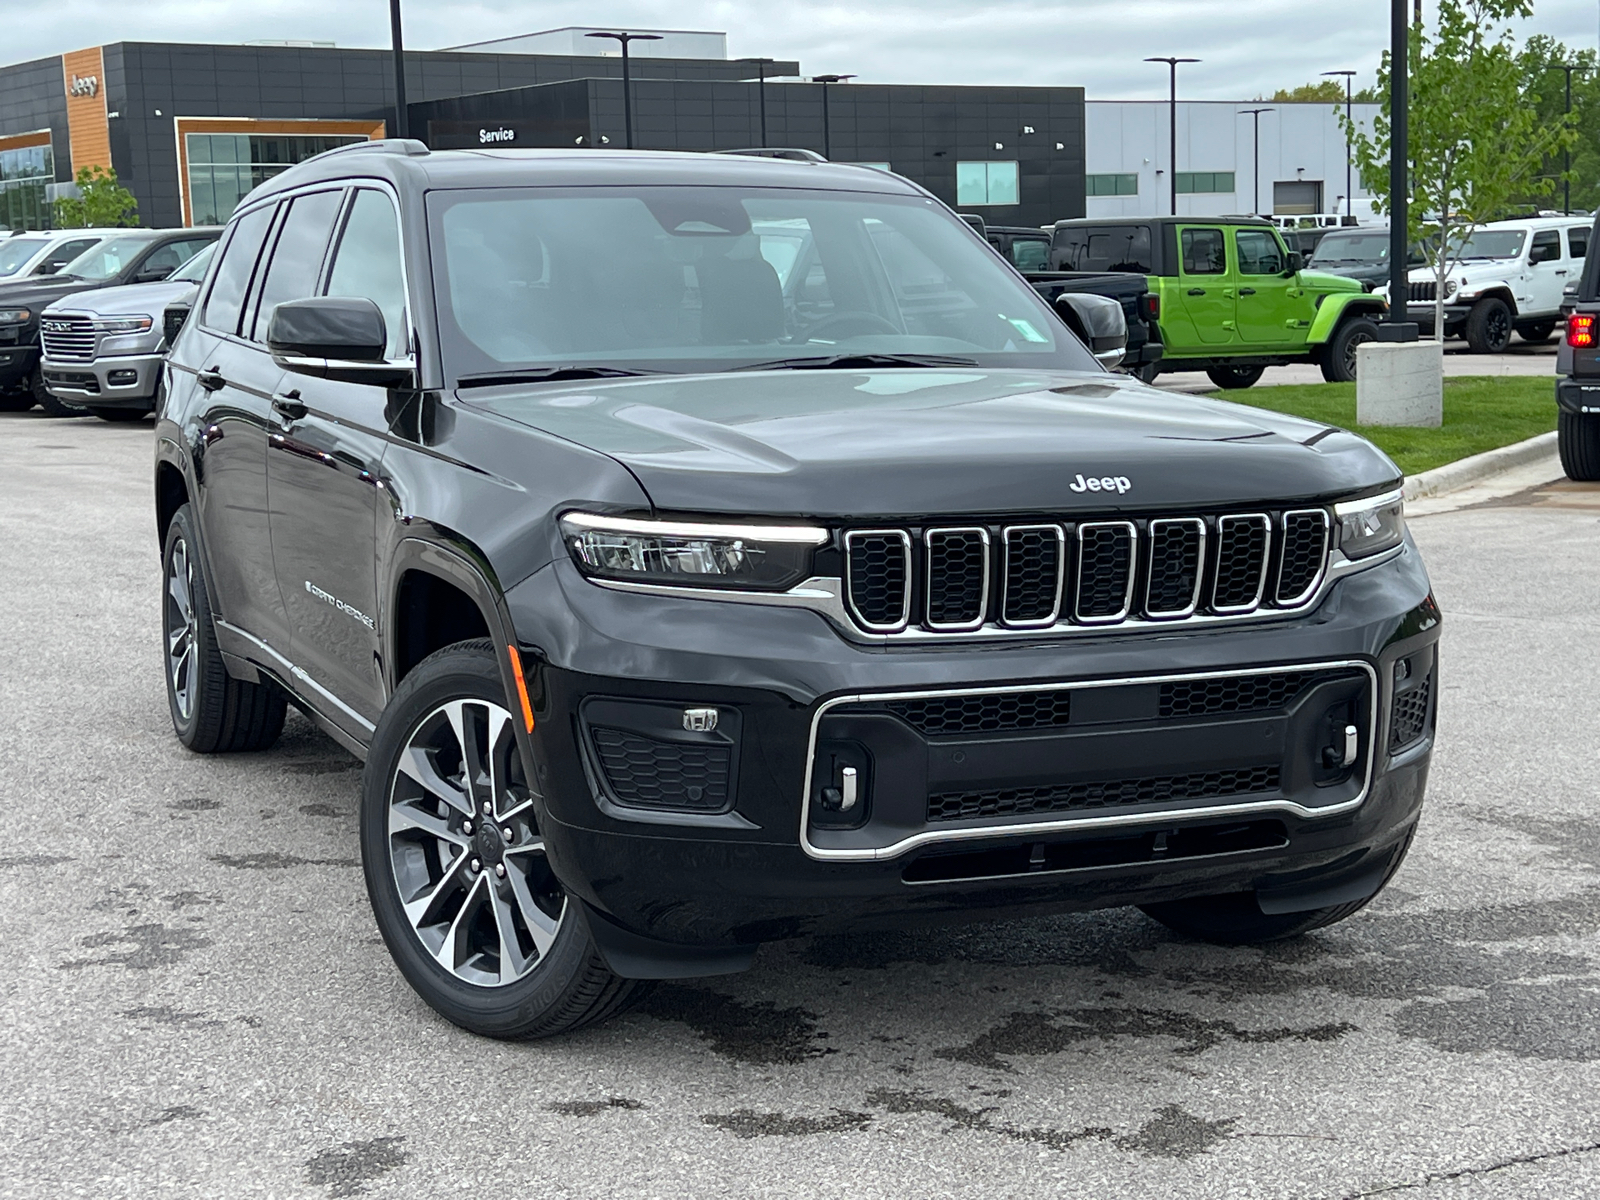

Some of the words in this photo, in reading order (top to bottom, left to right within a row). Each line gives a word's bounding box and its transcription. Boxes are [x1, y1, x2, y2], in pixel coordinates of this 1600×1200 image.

[71, 74, 98, 98] Jeep
[479, 126, 515, 144] Service
[1069, 473, 1132, 494] Jeep
